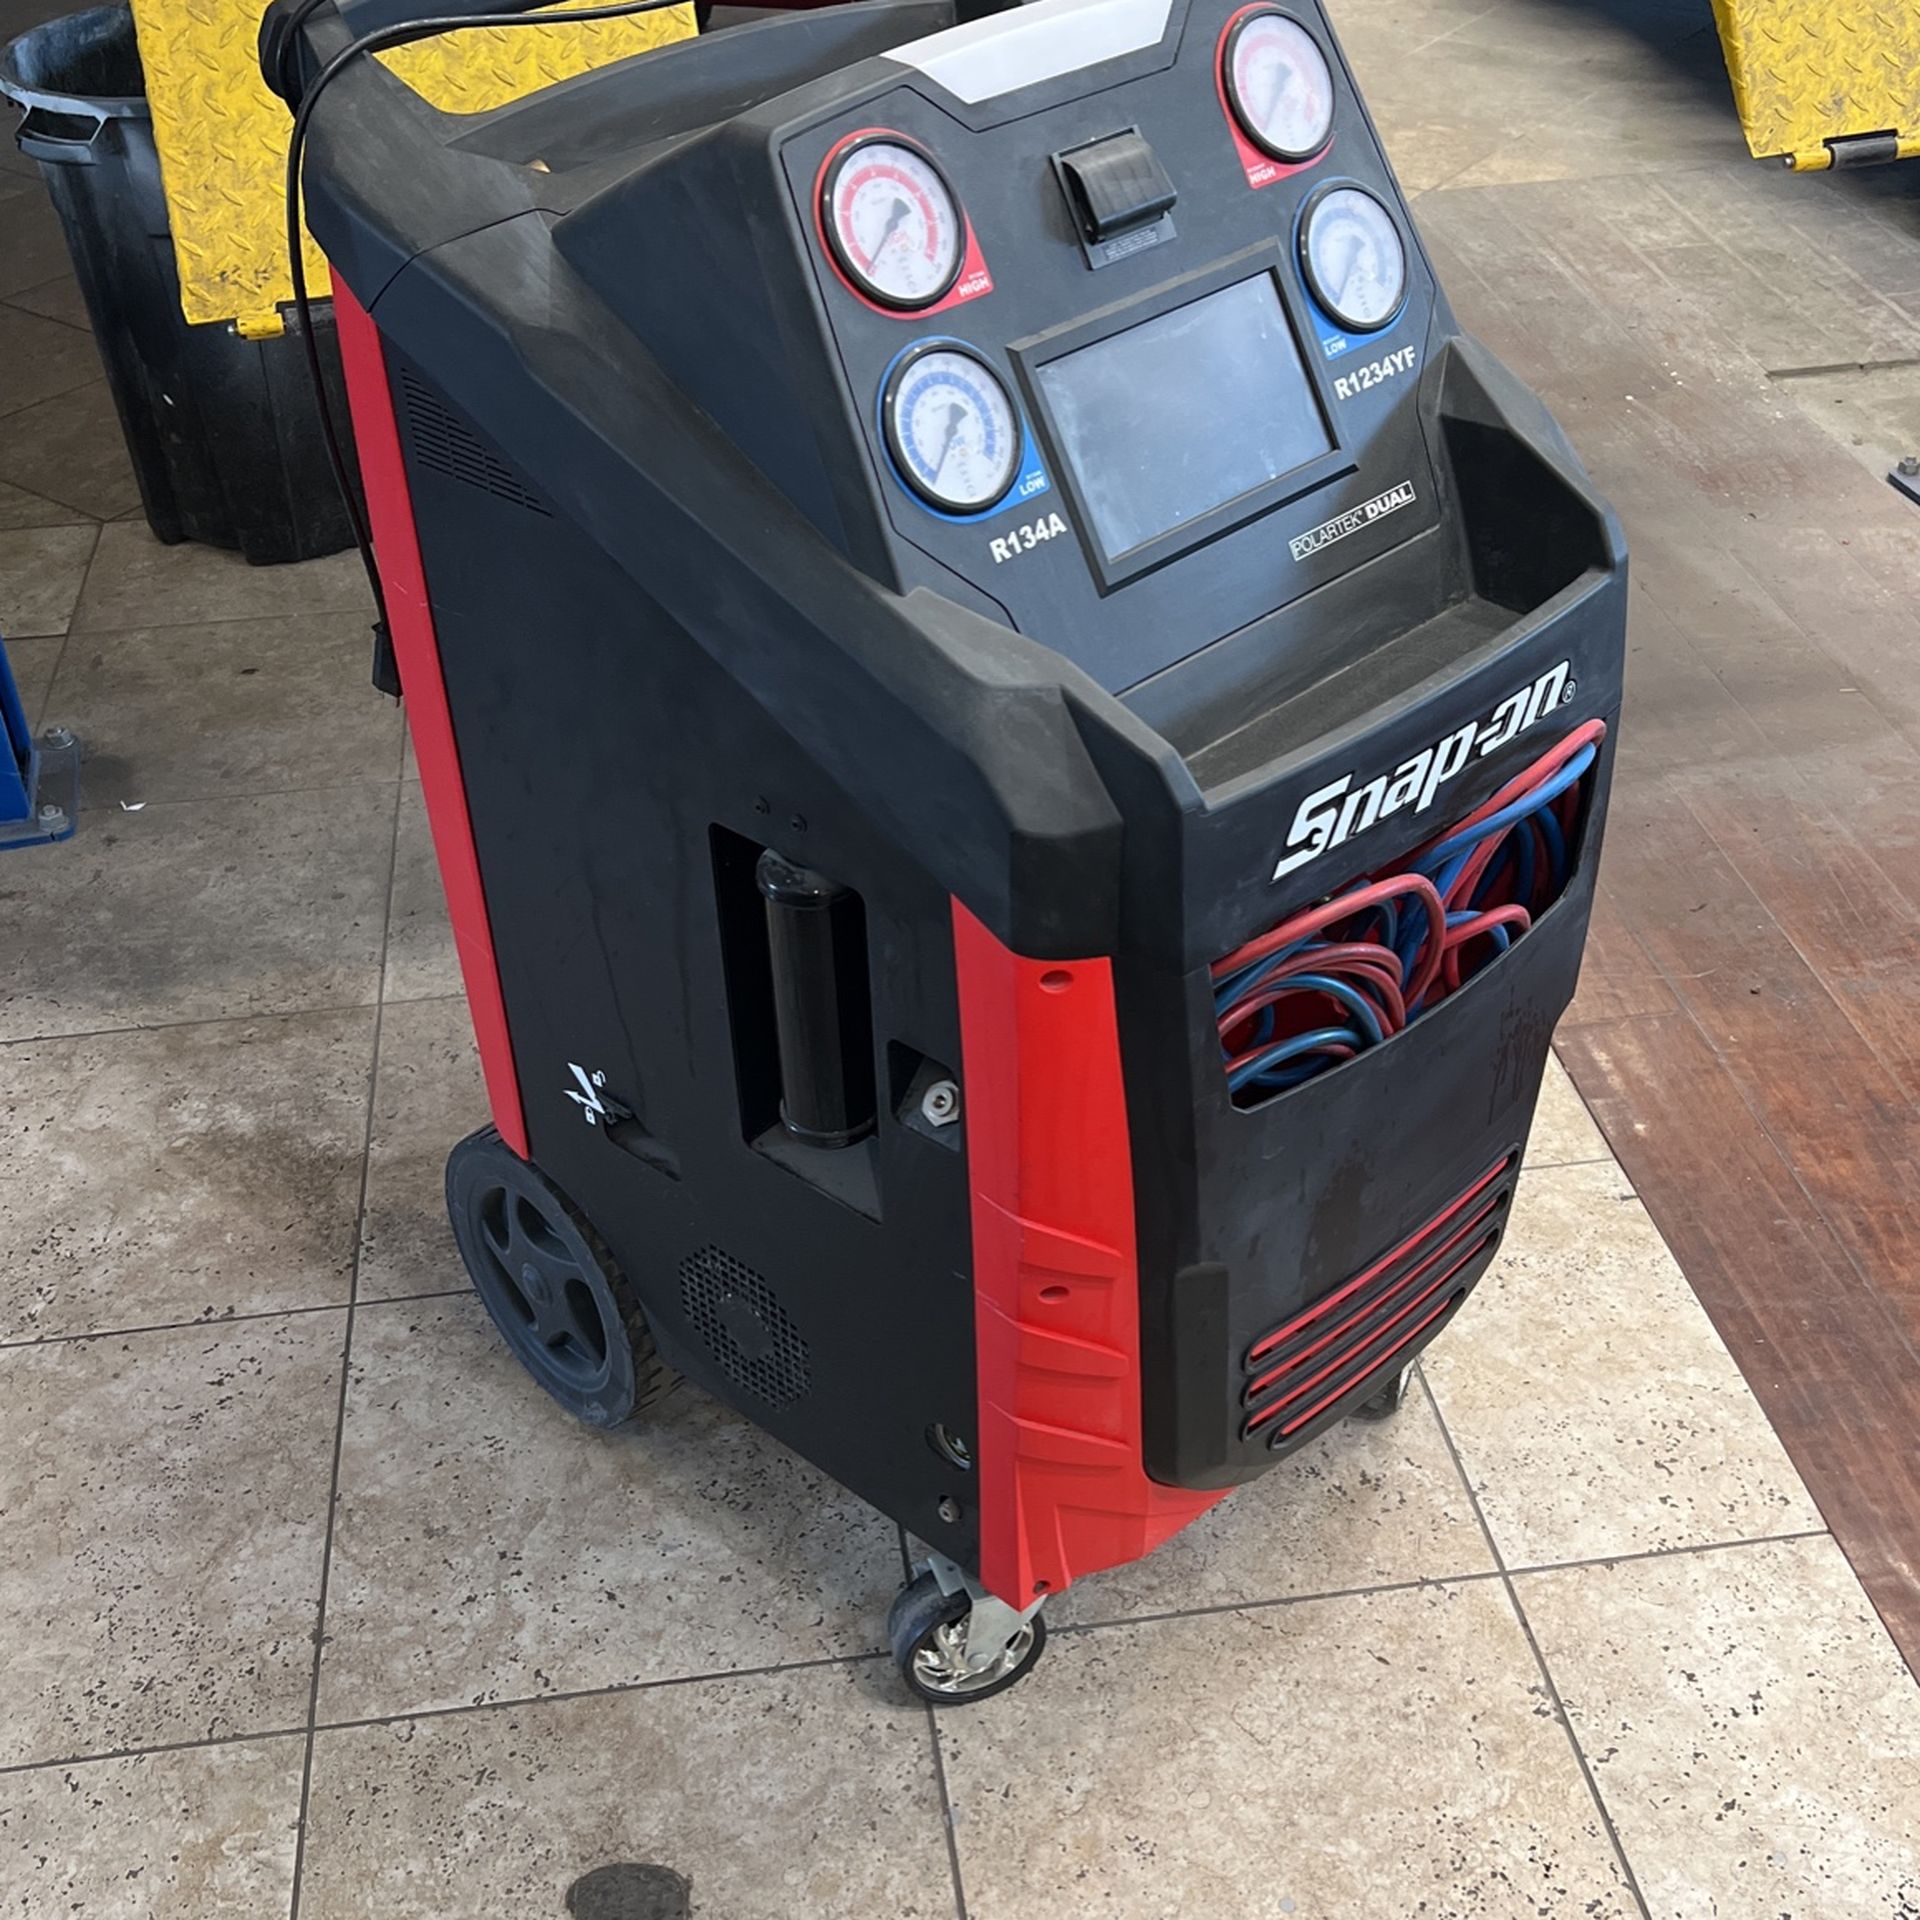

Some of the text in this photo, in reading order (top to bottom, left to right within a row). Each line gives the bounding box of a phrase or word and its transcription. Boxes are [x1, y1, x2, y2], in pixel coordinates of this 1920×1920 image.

[1249, 165, 1277, 184] HIGH
[958, 277, 990, 297] HIGH
[1324, 337, 1347, 356] LOW
[1334, 345, 1416, 400] R1234YF
[1019, 476, 1046, 496] LOW
[1364, 485, 1412, 519] DUAL
[988, 512, 1068, 564] R134A
